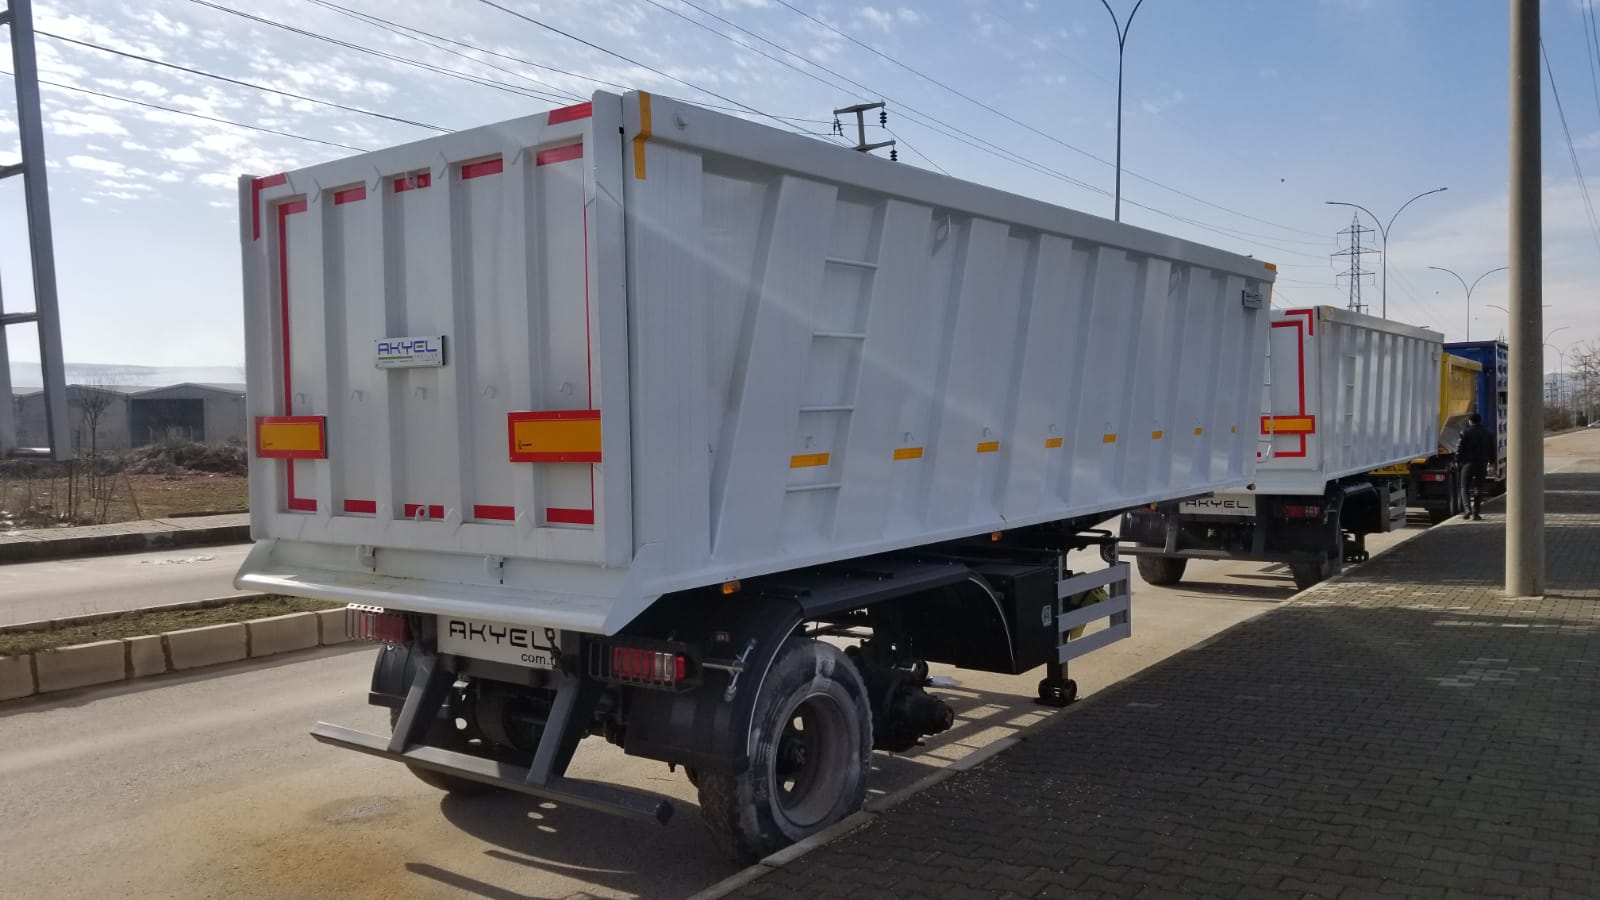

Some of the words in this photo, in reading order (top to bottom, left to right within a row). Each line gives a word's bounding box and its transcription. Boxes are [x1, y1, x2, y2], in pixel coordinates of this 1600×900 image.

[377, 340, 438, 355] AKYEL
[1185, 500, 1249, 509] AKYEL
[449, 619, 553, 652] AKYEL
